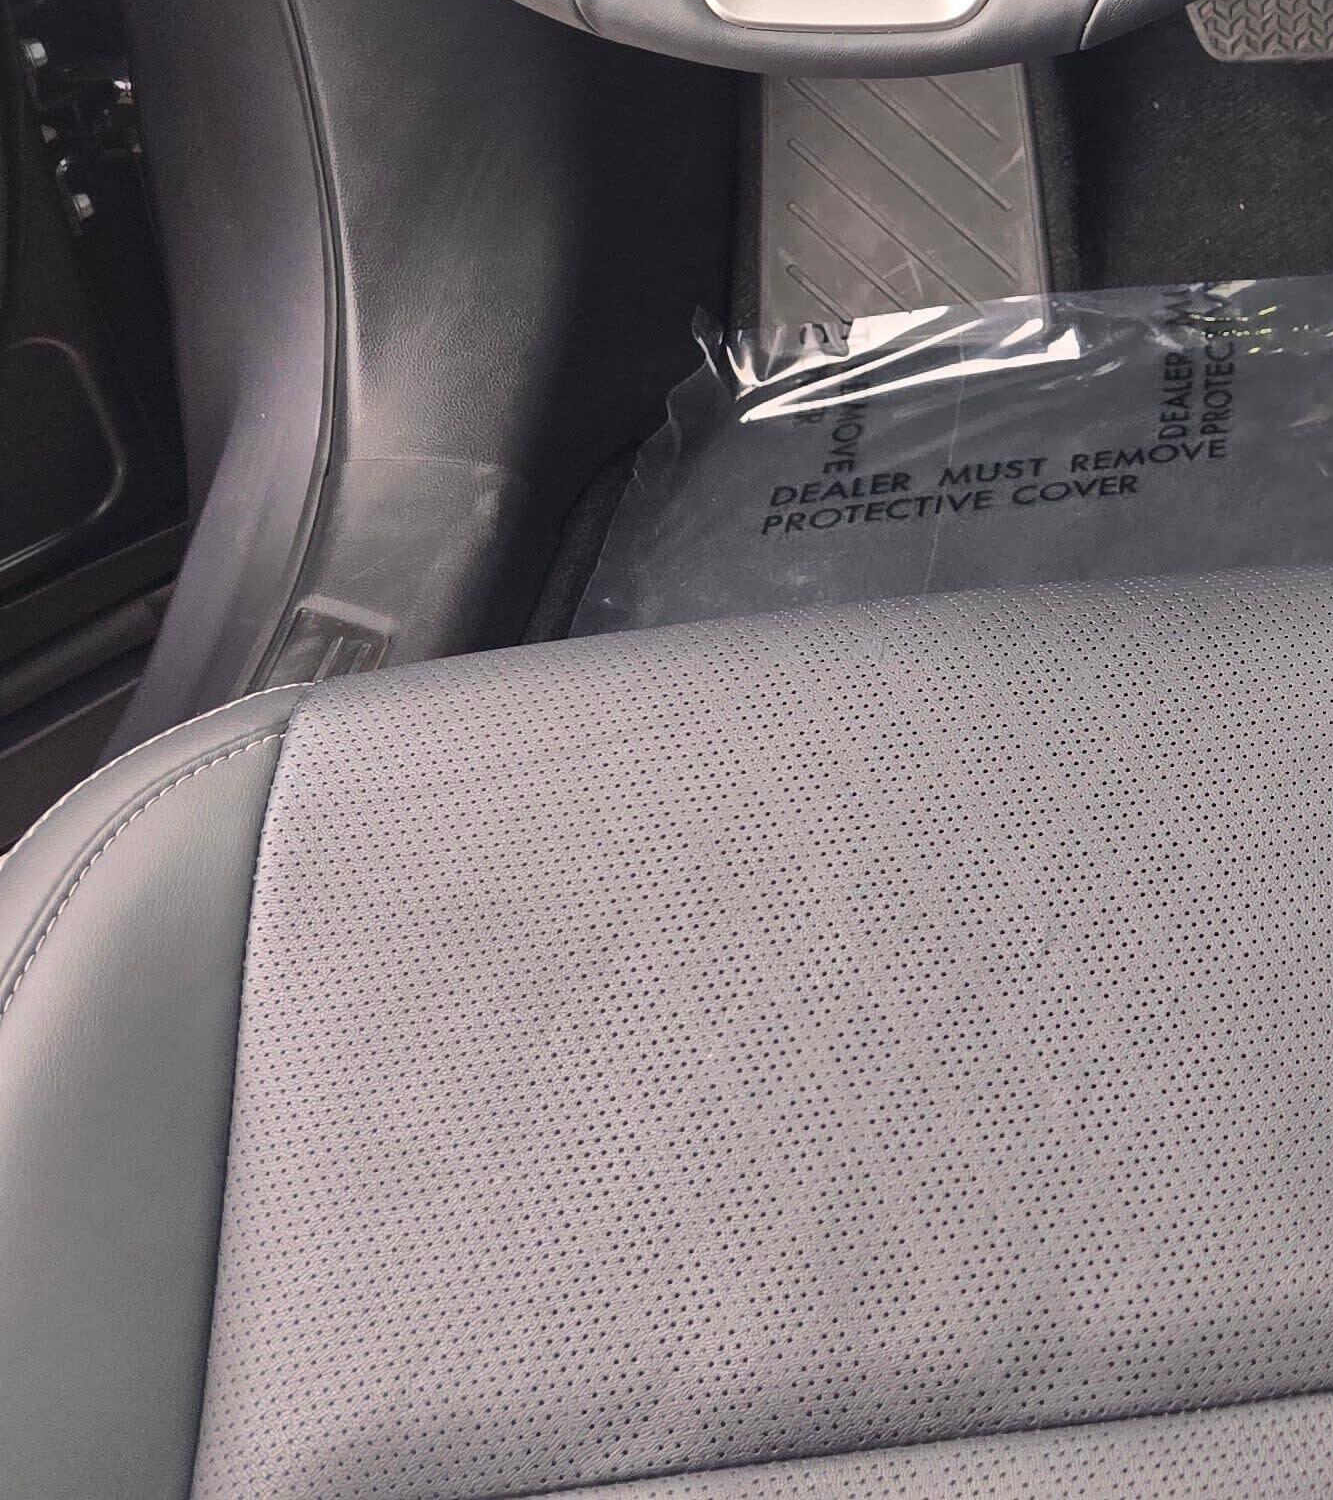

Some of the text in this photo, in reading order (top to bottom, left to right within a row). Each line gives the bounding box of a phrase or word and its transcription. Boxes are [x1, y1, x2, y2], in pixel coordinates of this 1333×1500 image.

[1159, 351, 1194, 441] DEALER
[761, 473, 1139, 536] PROTECTIVE COVER
[769, 438, 1228, 508] DEALER MUST REMOVE
